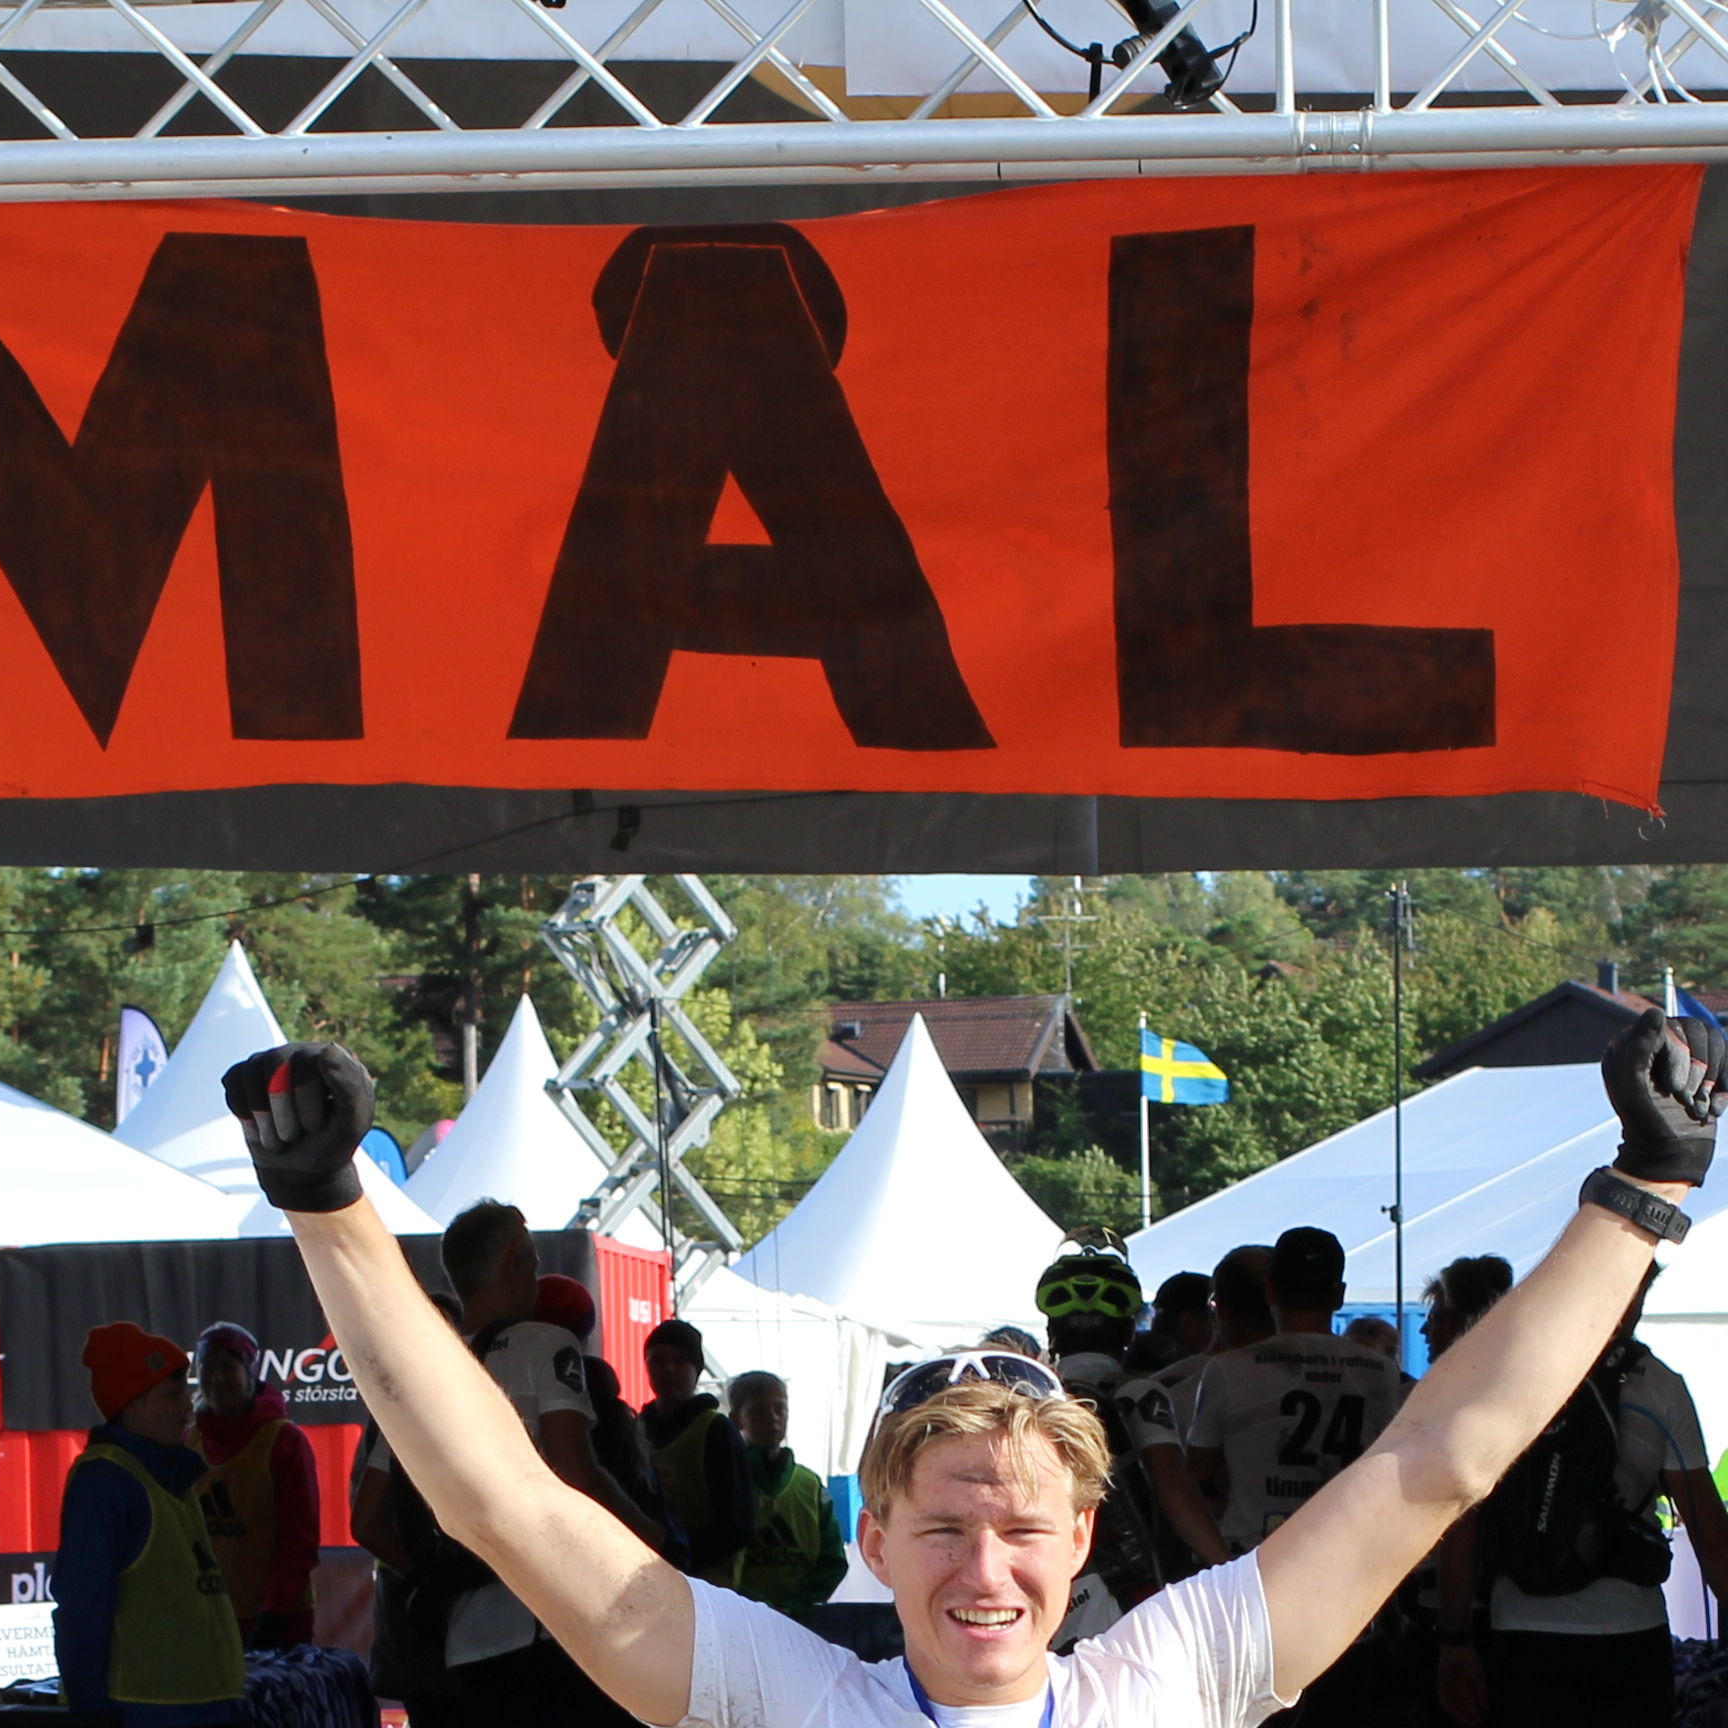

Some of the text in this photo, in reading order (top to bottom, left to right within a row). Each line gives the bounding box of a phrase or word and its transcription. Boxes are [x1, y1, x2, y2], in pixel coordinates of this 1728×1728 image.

[295, 1386, 358, 1403] största
[1278, 1389, 1365, 1469] 24
[1536, 1452, 1562, 1533] SALOMON
